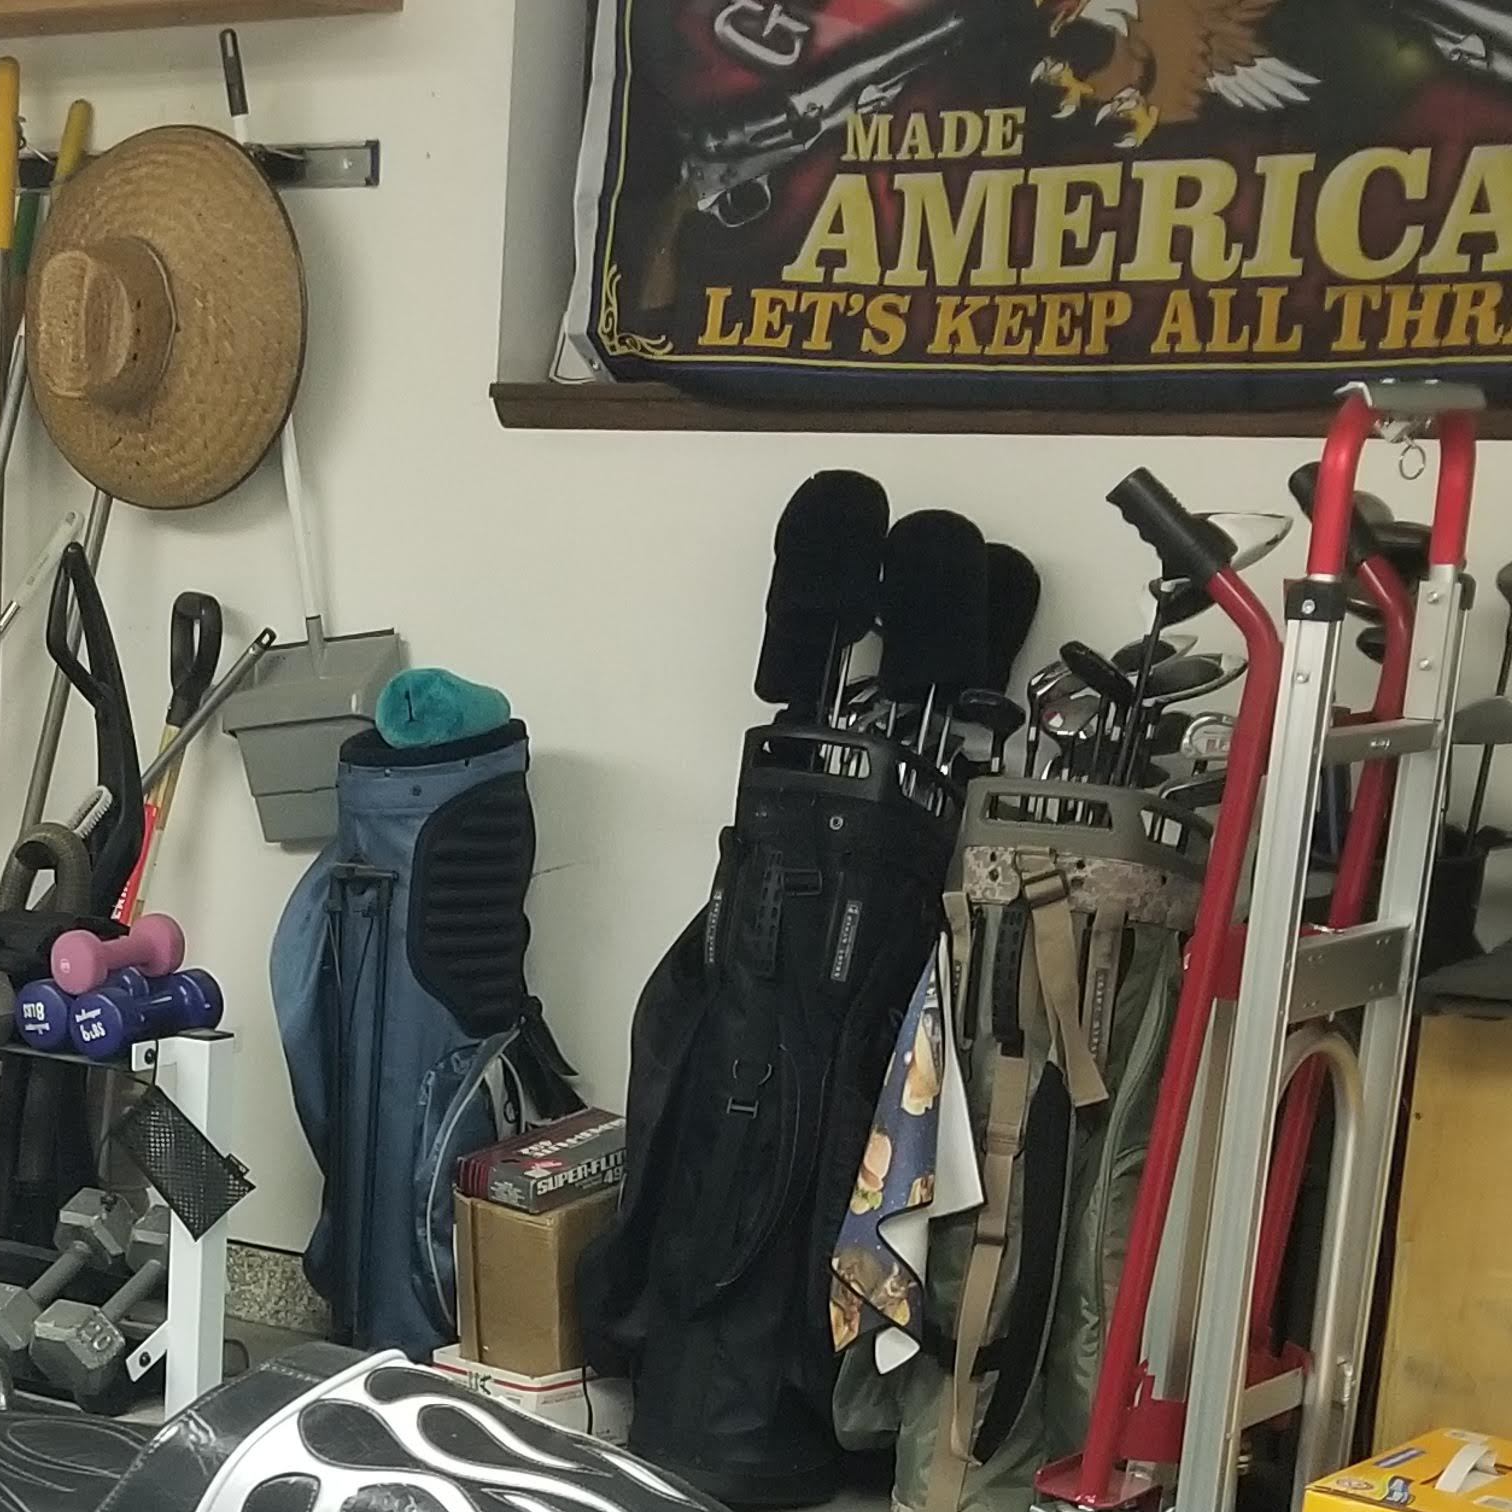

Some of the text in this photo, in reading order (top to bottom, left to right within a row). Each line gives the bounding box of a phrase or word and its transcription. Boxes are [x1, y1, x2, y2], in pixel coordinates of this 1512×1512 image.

[841, 107, 1025, 163] MADE
[781, 144, 1512, 288] AMERICA
[698, 281, 1512, 355] LET'S KEEP ALL THR
